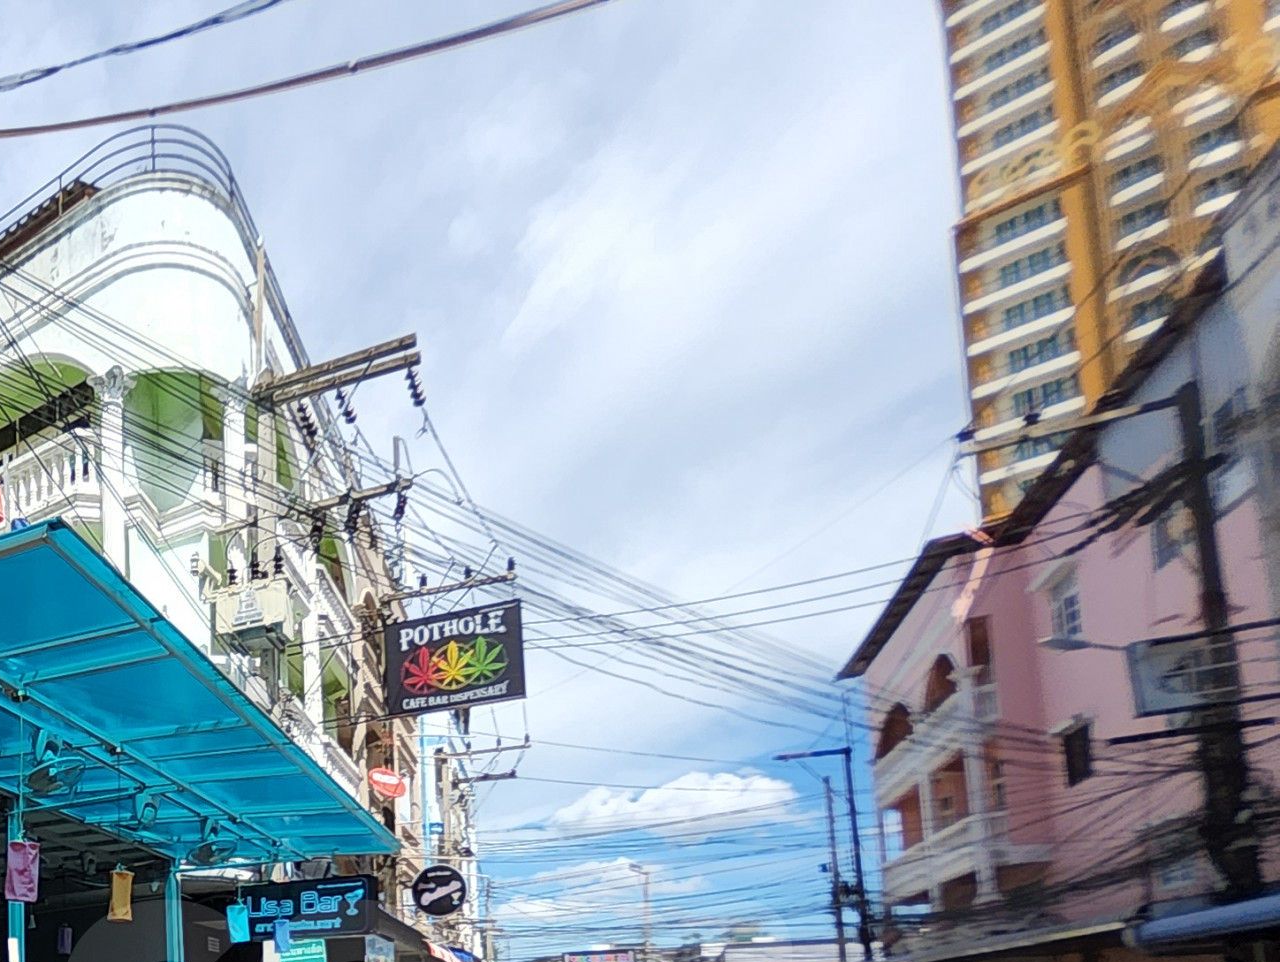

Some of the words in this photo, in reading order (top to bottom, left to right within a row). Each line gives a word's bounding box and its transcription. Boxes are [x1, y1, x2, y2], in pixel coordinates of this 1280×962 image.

[399, 610, 508, 651] POTHOLE
[402, 696, 428, 711] CAFE
[428, 694, 449, 707] BAR
[450, 680, 509, 703] DISPENSARY
[247, 896, 294, 917] Lisa
[300, 890, 342, 914] Bar
